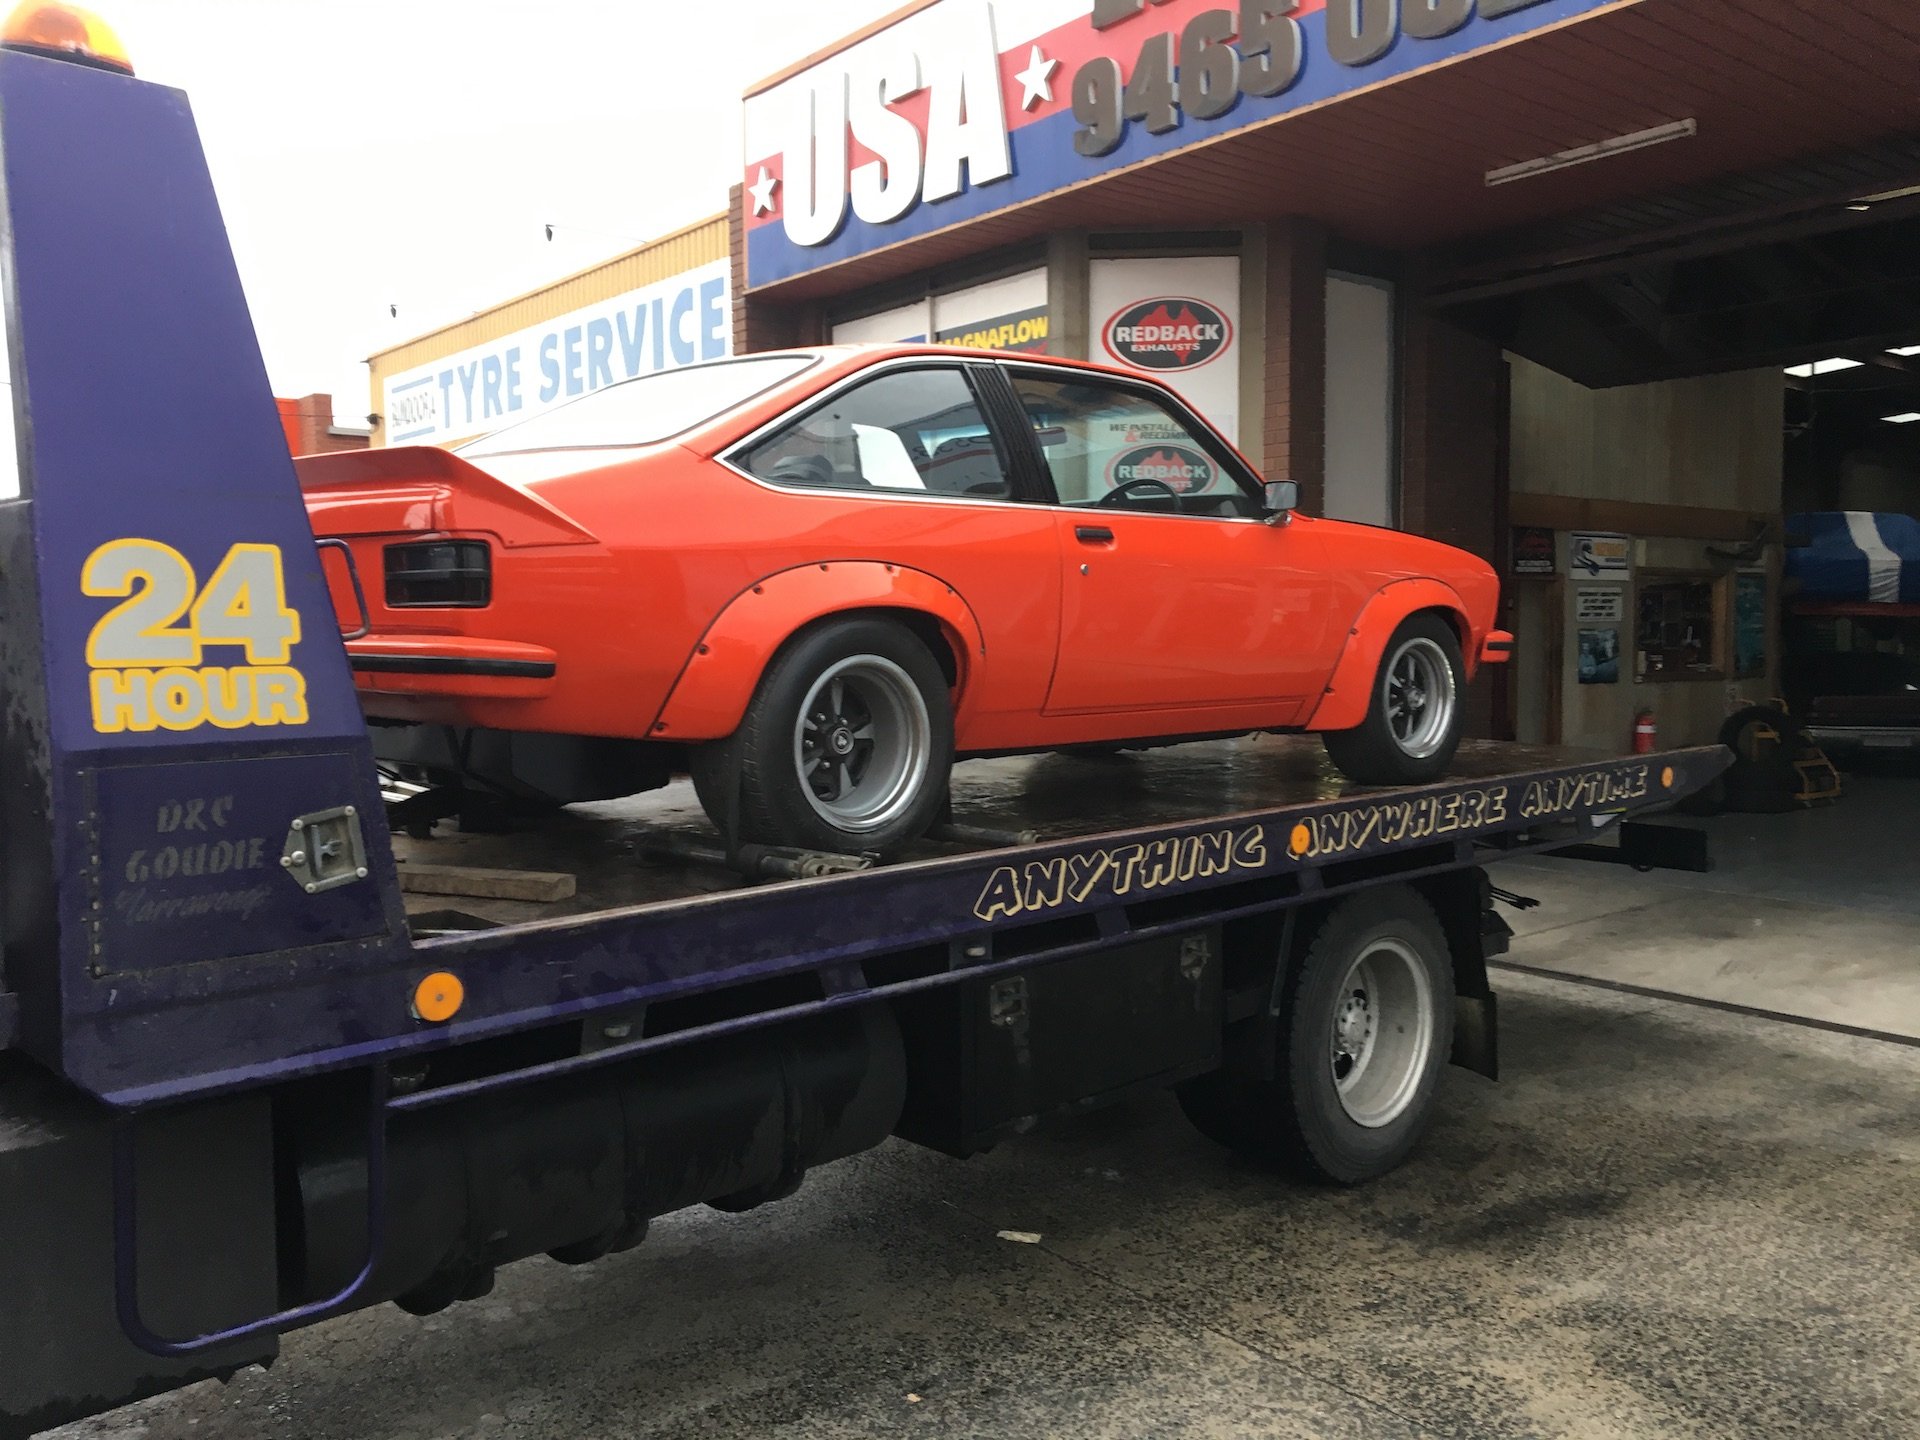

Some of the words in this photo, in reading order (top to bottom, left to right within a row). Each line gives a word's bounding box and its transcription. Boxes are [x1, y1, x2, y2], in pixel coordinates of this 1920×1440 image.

[1072, 0, 1303, 157] 9465
[778, 1, 1012, 247] USA
[439, 346, 522, 428] TYRE
[539, 277, 726, 403] SERVICE
[938, 316, 1049, 349] GNAFLOW
[1116, 324, 1219, 342] REDBACK
[1131, 343, 1200, 352] EXHAUSTS
[1110, 423, 1128, 431] WE
[1118, 464, 1207, 479] REDBACK
[80, 537, 301, 668] 24
[89, 666, 309, 733] HOUR
[125, 837, 267, 883] GOUDIE
[972, 824, 1267, 922] ANYTHING
[1519, 764, 1649, 818] ANYTIME
